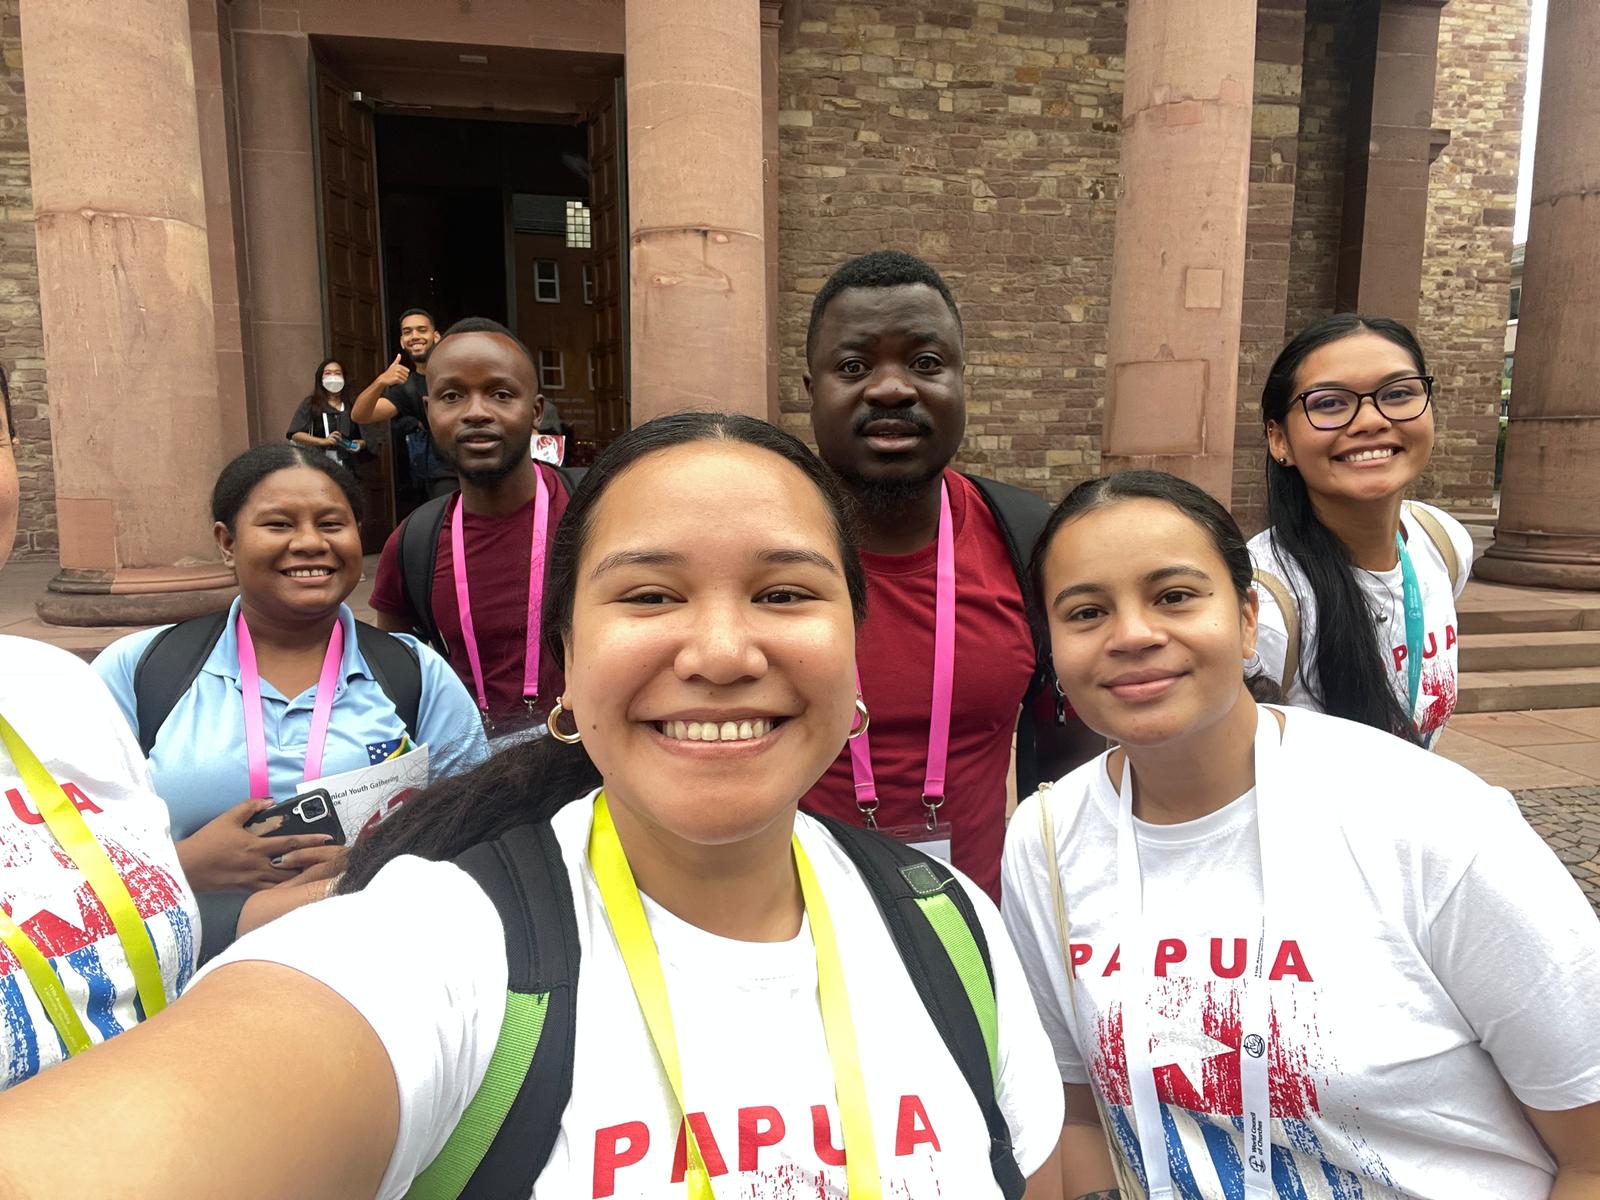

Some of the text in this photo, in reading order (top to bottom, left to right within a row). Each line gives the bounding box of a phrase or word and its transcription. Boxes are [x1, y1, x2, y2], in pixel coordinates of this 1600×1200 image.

[1392, 624, 1457, 672] PUA
[330, 775, 399, 800] nical Youth Gathering
[592, 1094, 942, 1200] PAPUA
